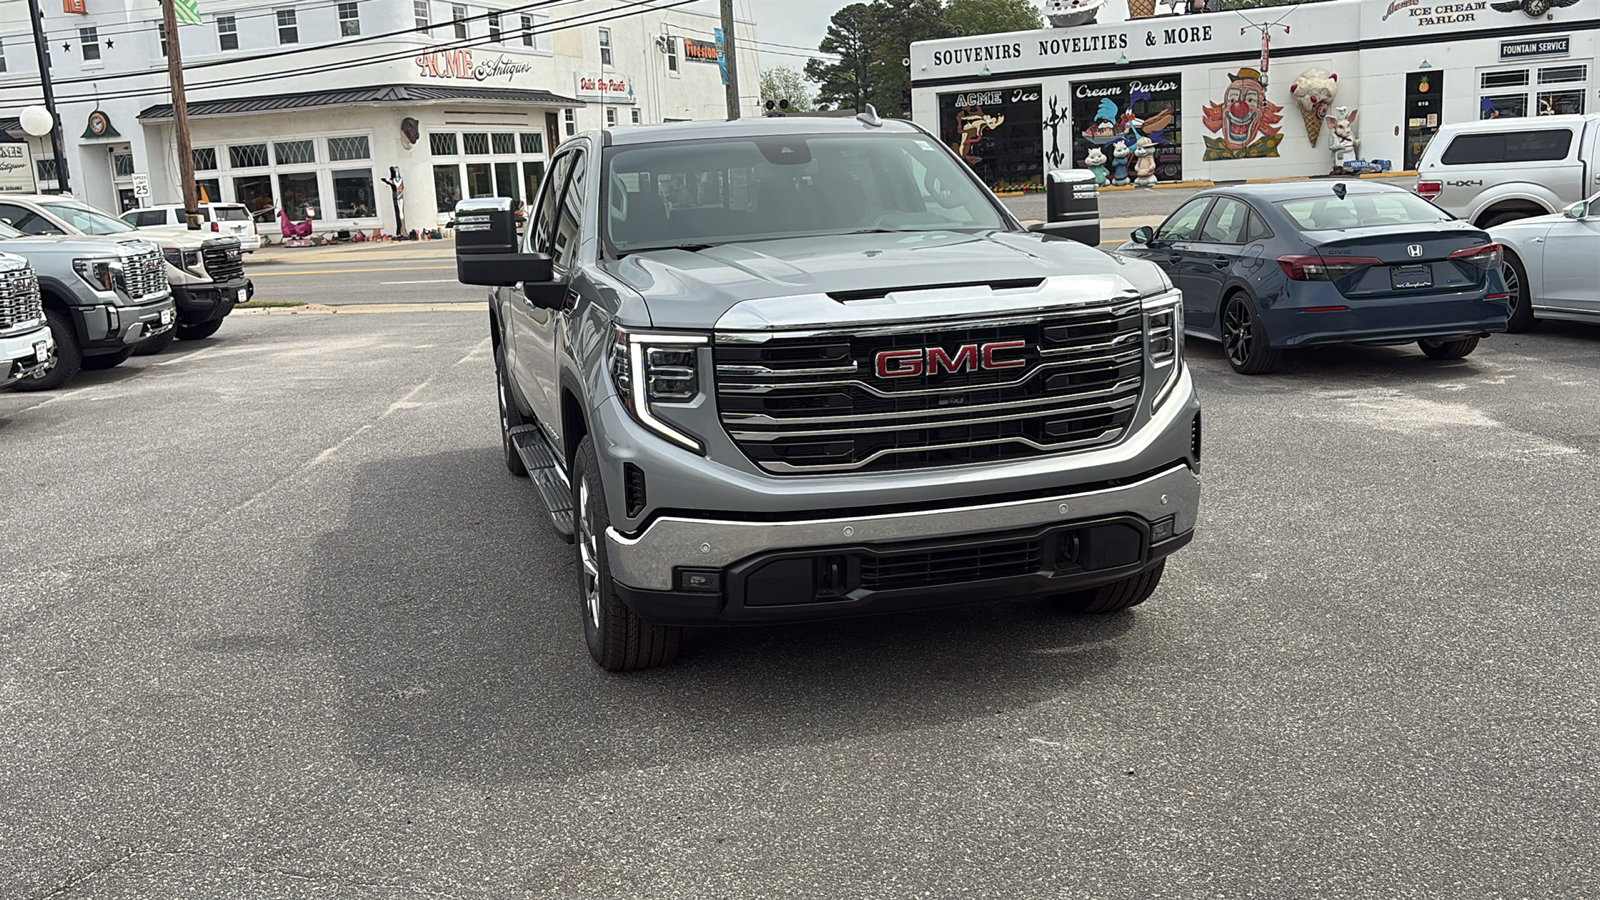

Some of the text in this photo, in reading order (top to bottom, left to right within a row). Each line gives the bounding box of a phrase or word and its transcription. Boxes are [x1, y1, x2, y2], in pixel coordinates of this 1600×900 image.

[1409, 1, 1487, 17] ICE CREAM
[1418, 13, 1475, 26] PARLOR
[684, 39, 717, 59] Fireston
[934, 25, 1212, 66] SOUVENIRS NOVELTIES & MORE
[1503, 41, 1567, 55] FOUNTAIN SERVICE
[415, 47, 532, 82] ACME Antiques
[580, 77, 626, 94] Dutch Boy Paints
[1076, 80, 1178, 98] Cream Parlor
[955, 89, 1039, 108] ACME Ice
[135, 185, 149, 195] 25
[875, 339, 1026, 379] GMC
